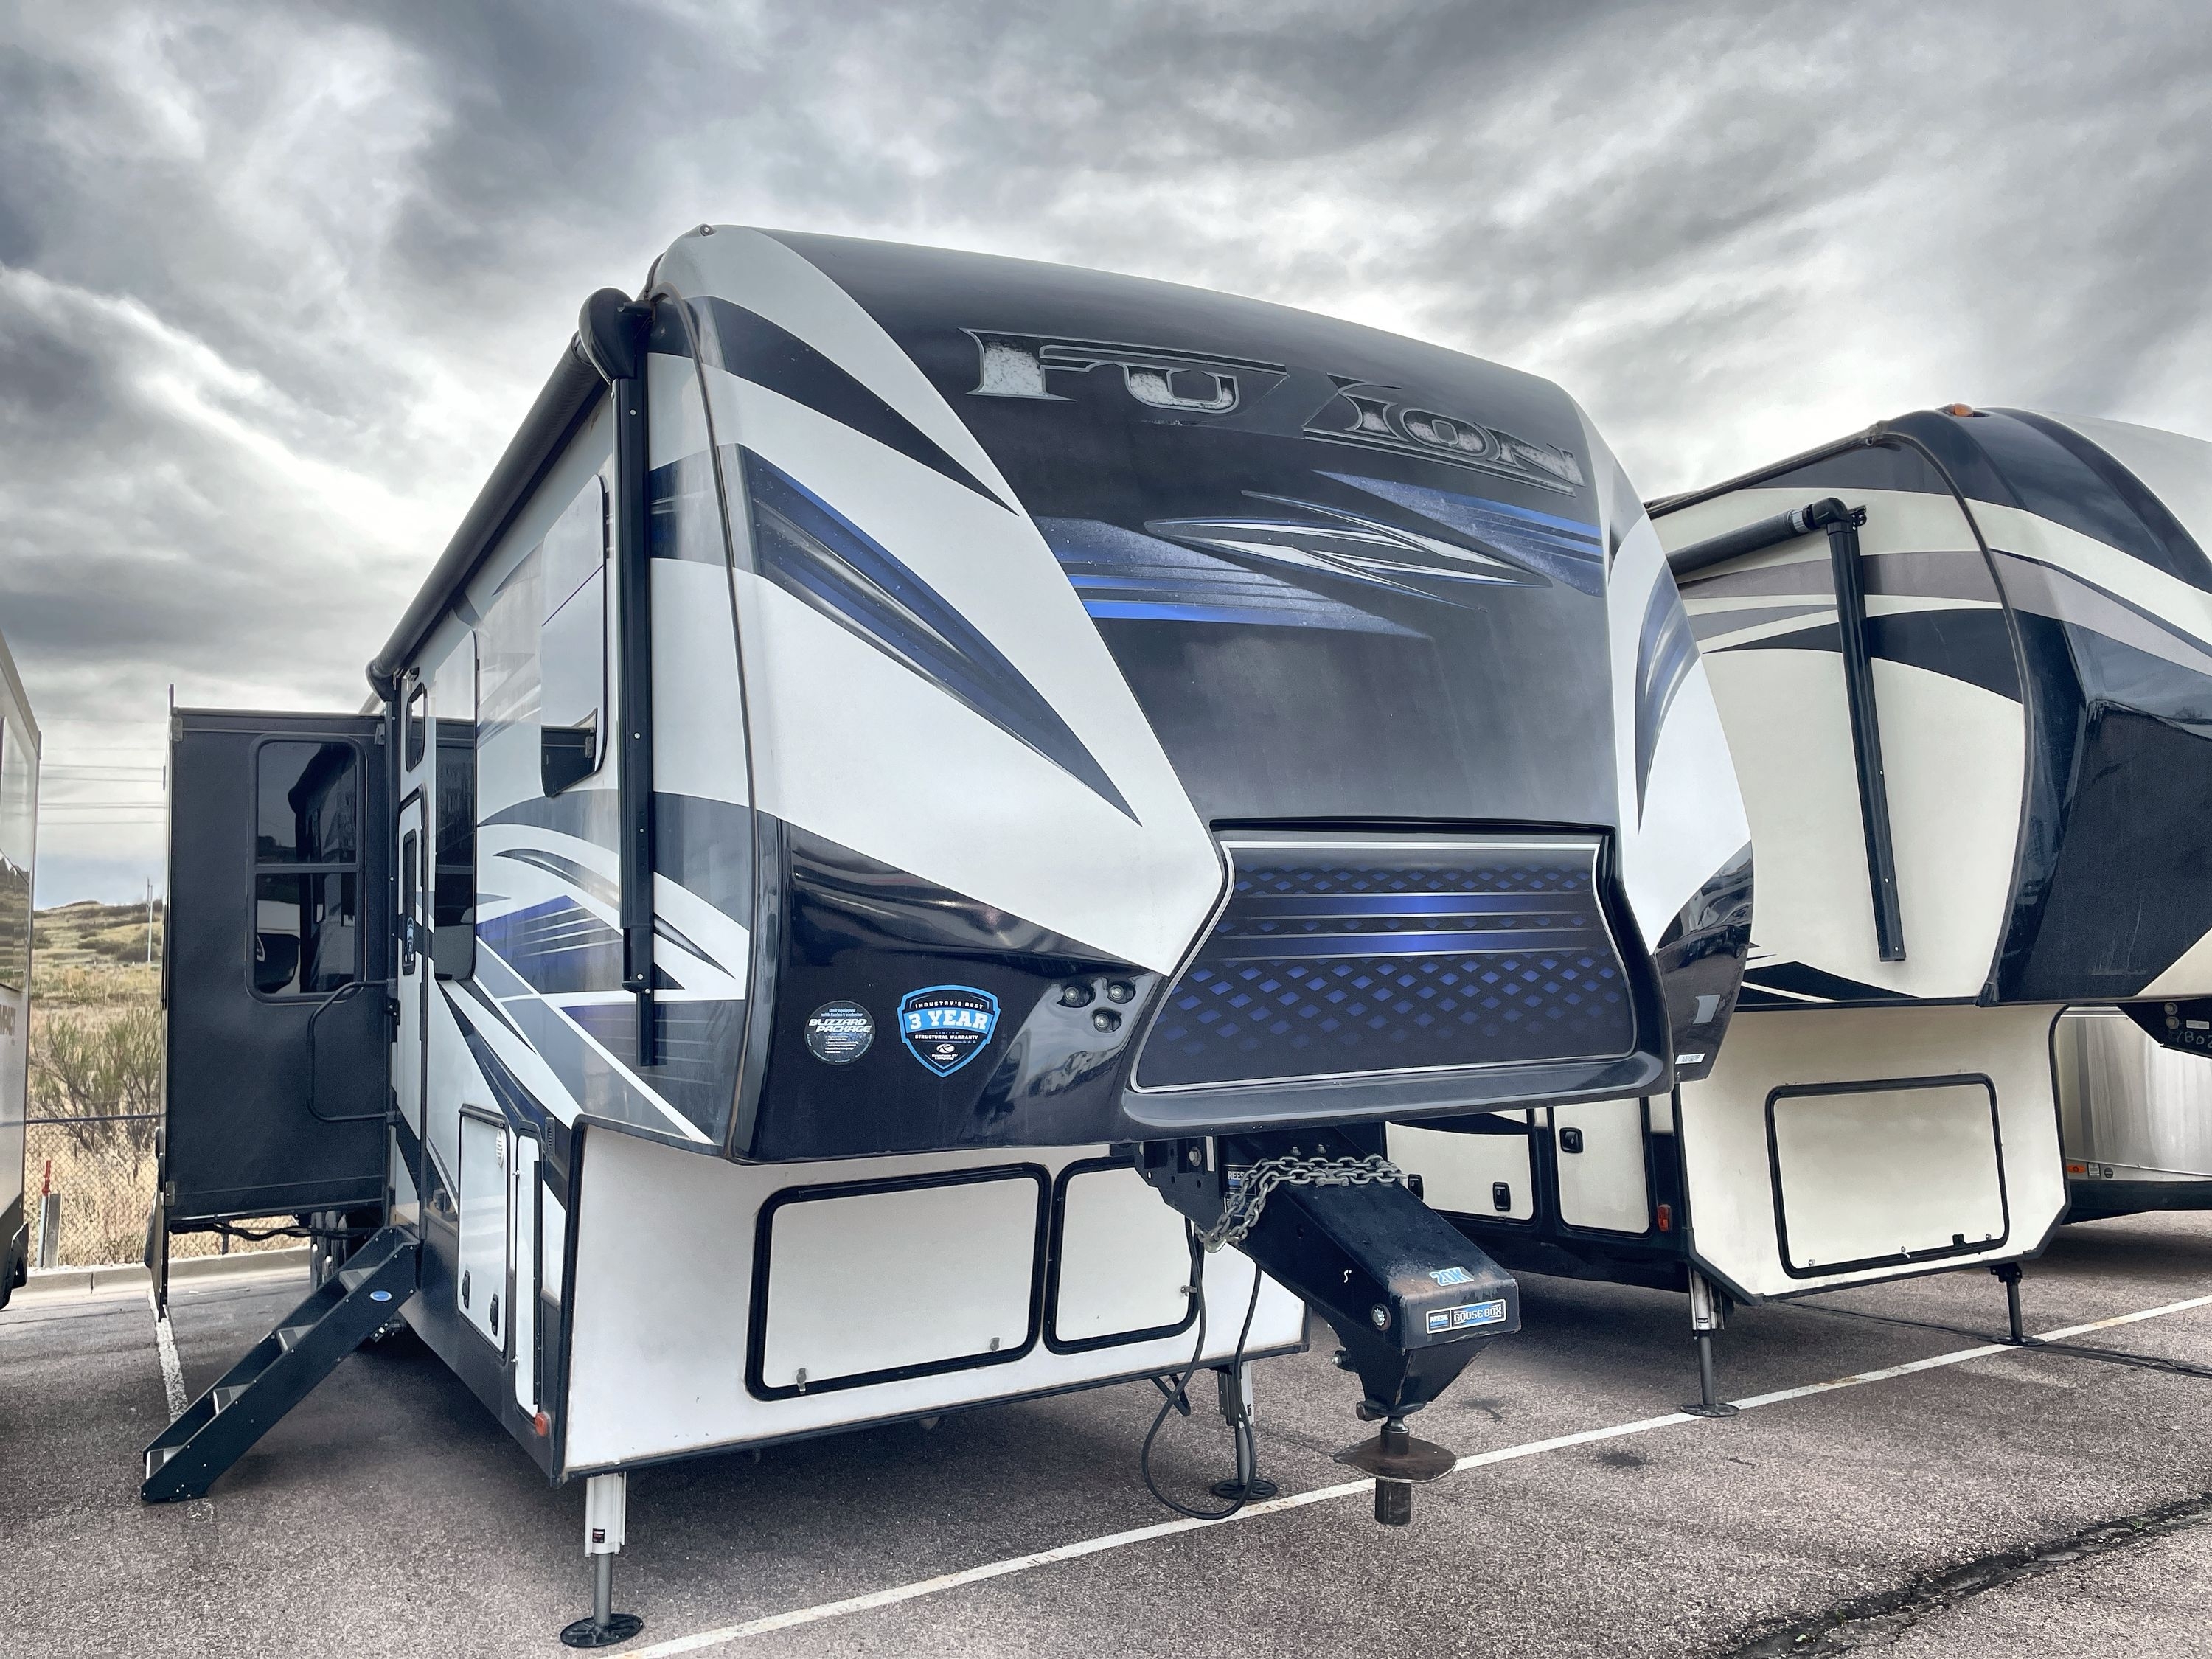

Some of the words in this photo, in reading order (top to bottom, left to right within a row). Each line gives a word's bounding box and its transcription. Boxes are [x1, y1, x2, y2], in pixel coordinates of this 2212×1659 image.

[915, 1001, 962, 1009] INDUSTRY'S
[808, 1018, 867, 1026] BLIZZARD
[908, 1012, 922, 1030] 3
[928, 1009, 988, 1030] YEAR
[1228, 1170, 1250, 1180] REES
[1429, 1267, 1475, 1287] 20K
[1429, 1314, 1449, 1323] REESE
[1453, 1309, 1484, 1323] GOOSE
[1484, 1305, 1502, 1318] BOX
